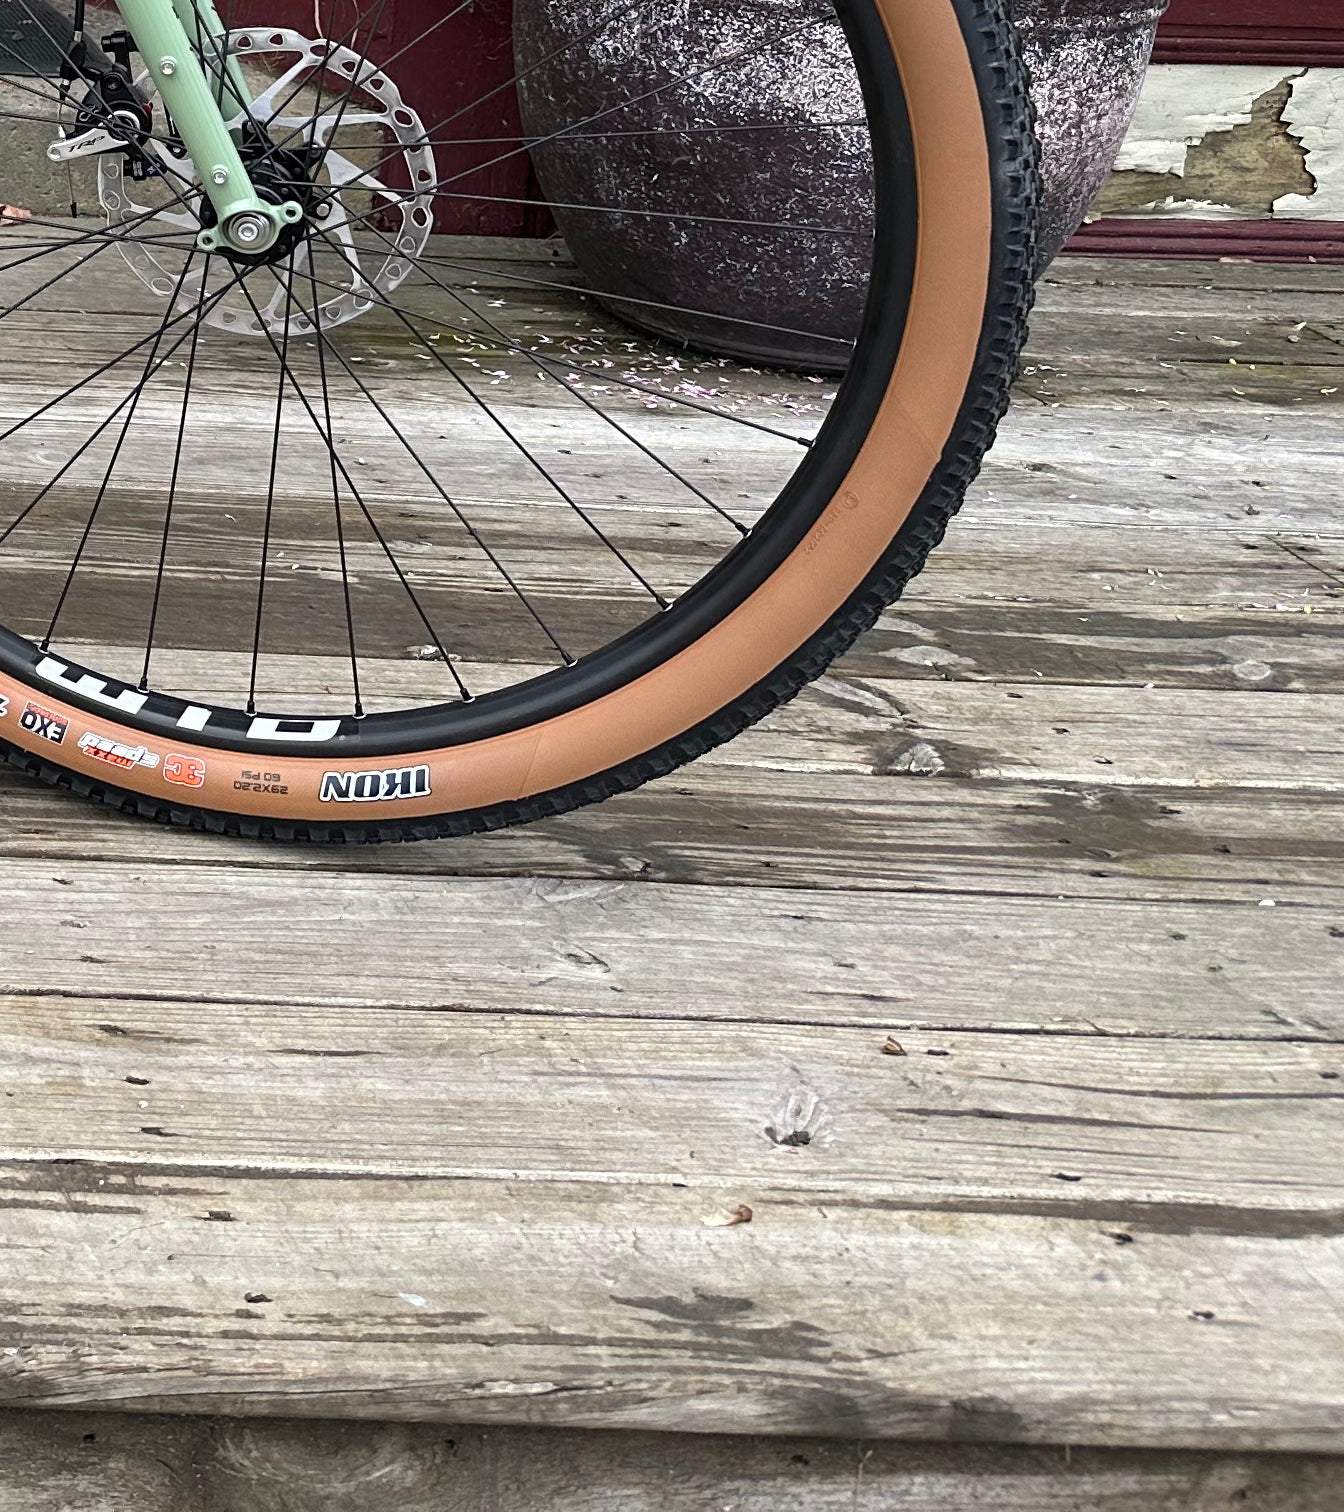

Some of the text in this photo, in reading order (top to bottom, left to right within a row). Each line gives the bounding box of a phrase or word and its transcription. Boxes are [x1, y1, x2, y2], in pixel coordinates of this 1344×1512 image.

[20, 709, 66, 743] EXO
[78, 732, 160, 769] speed
[240, 770, 262, 781] PSI
[264, 771, 282, 782] 60
[318, 765, 432, 803] IKON
[233, 781, 289, 795] 29X2.20
